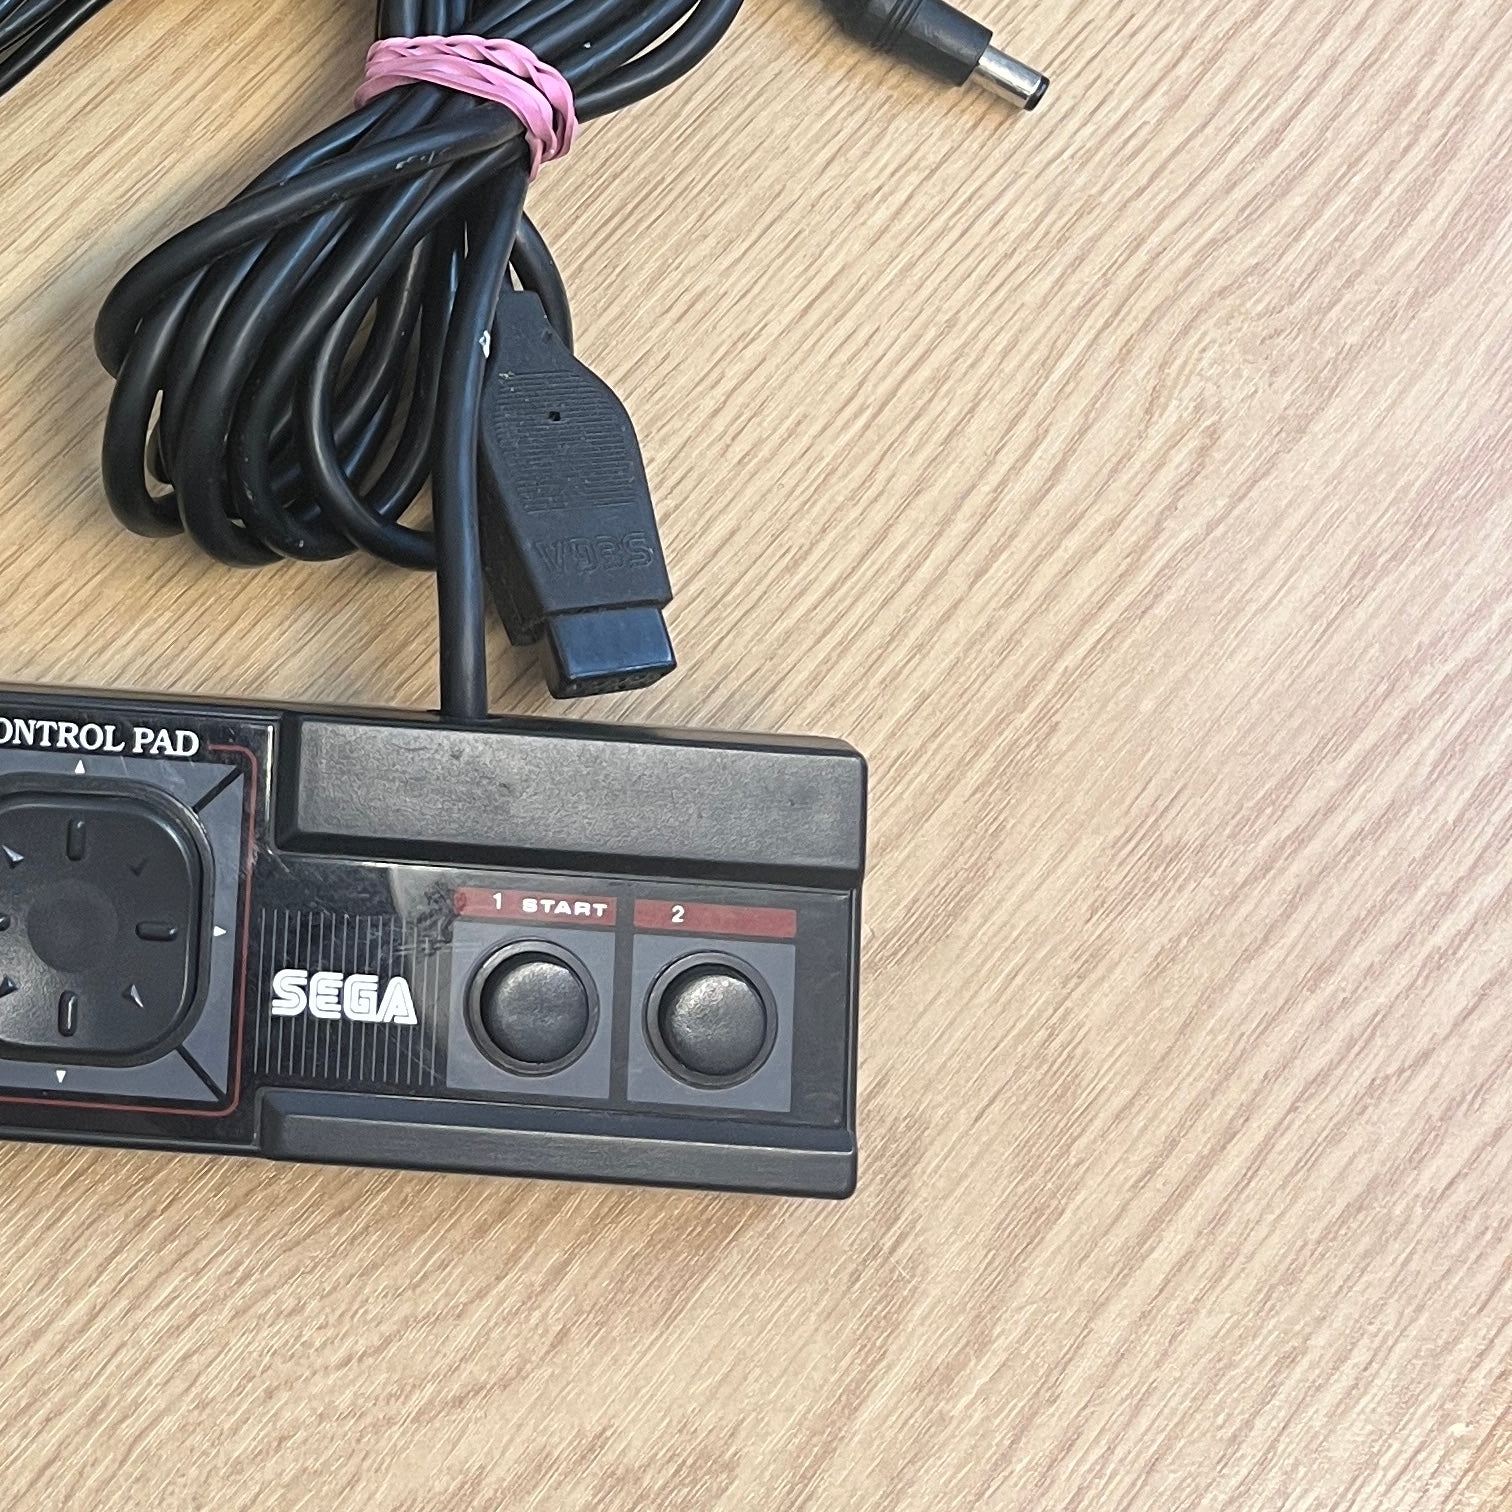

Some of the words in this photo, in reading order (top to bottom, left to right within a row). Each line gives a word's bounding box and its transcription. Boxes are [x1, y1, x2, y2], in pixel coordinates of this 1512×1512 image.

[535, 533, 654, 574] SEGA
[132, 728, 200, 756] PAD
[492, 892, 503, 911] 1
[520, 897, 608, 919] START
[672, 905, 685, 924] 2
[271, 968, 418, 1026] SEGA
